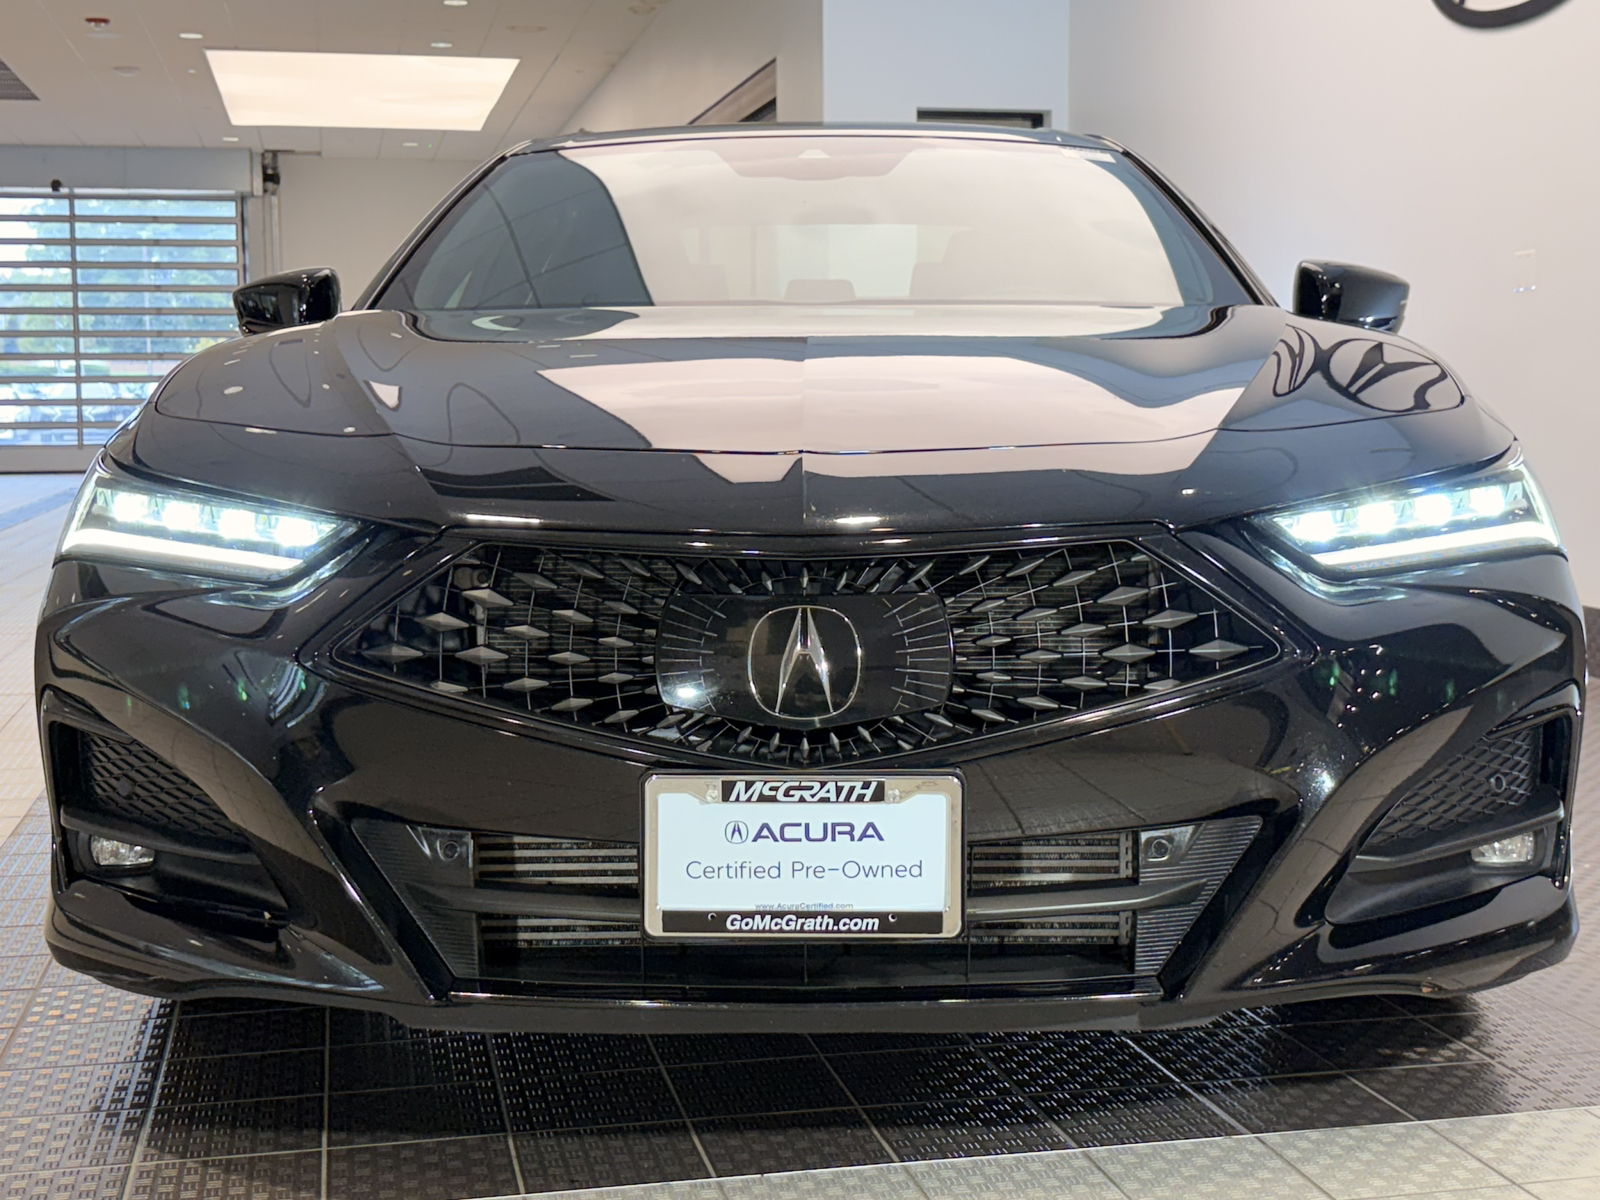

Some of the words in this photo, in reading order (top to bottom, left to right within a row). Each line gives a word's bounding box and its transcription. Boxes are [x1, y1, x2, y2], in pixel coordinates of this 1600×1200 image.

[751, 822, 885, 842] ACURA
[685, 861, 781, 880] Certified
[791, 860, 923, 879] Pre-Owned
[726, 914, 879, 931] GoMcGrath.com
